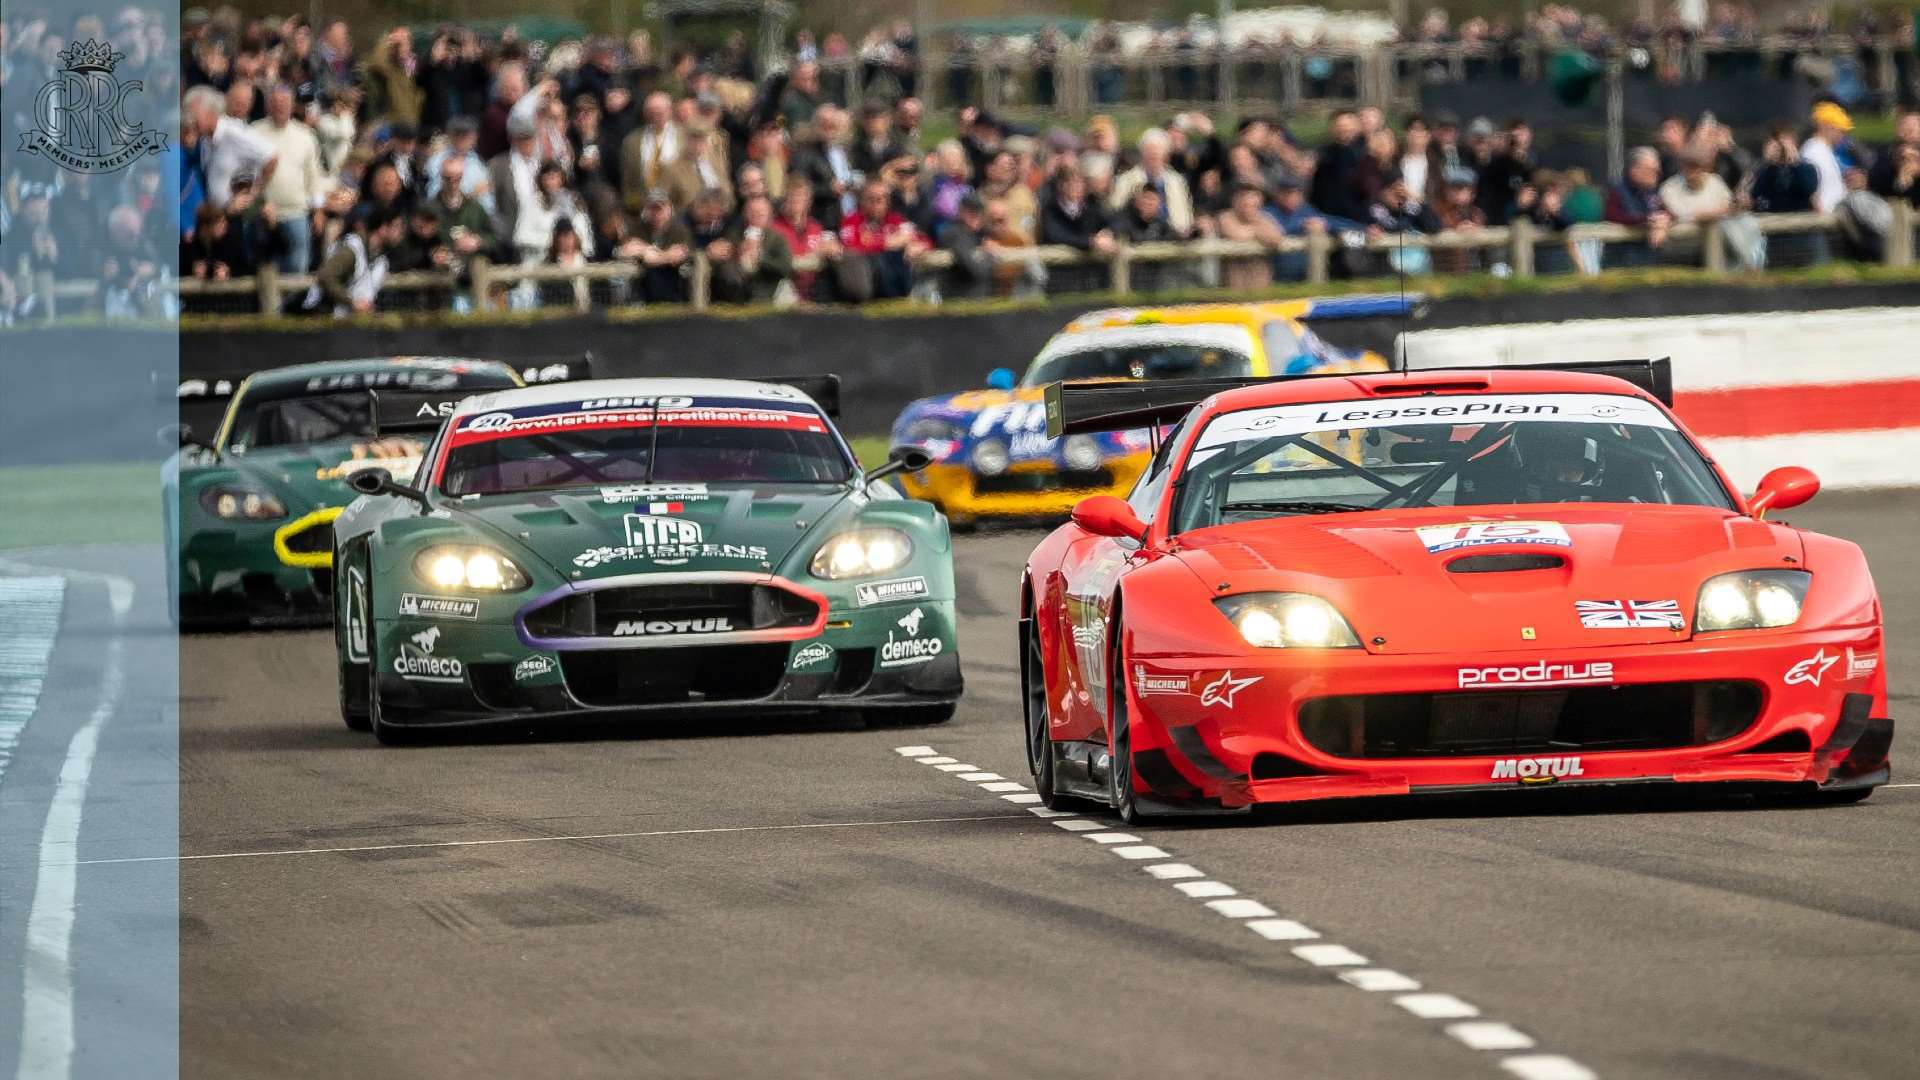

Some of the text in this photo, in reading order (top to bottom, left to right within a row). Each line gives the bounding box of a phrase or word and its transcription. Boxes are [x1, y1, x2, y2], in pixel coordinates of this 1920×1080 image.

[416, 401, 460, 417] AS
[1315, 402, 1561, 424] LeasePlan
[877, 579, 924, 597] MICHELIN
[419, 600, 475, 614] MICHELIN
[612, 617, 734, 636] MOTUL
[881, 630, 943, 661] demeco
[393, 643, 463, 676] demeco
[1458, 660, 1614, 688] prodrive
[1146, 679, 1187, 690] MICHELIN
[1491, 757, 1585, 779] MOTUL
